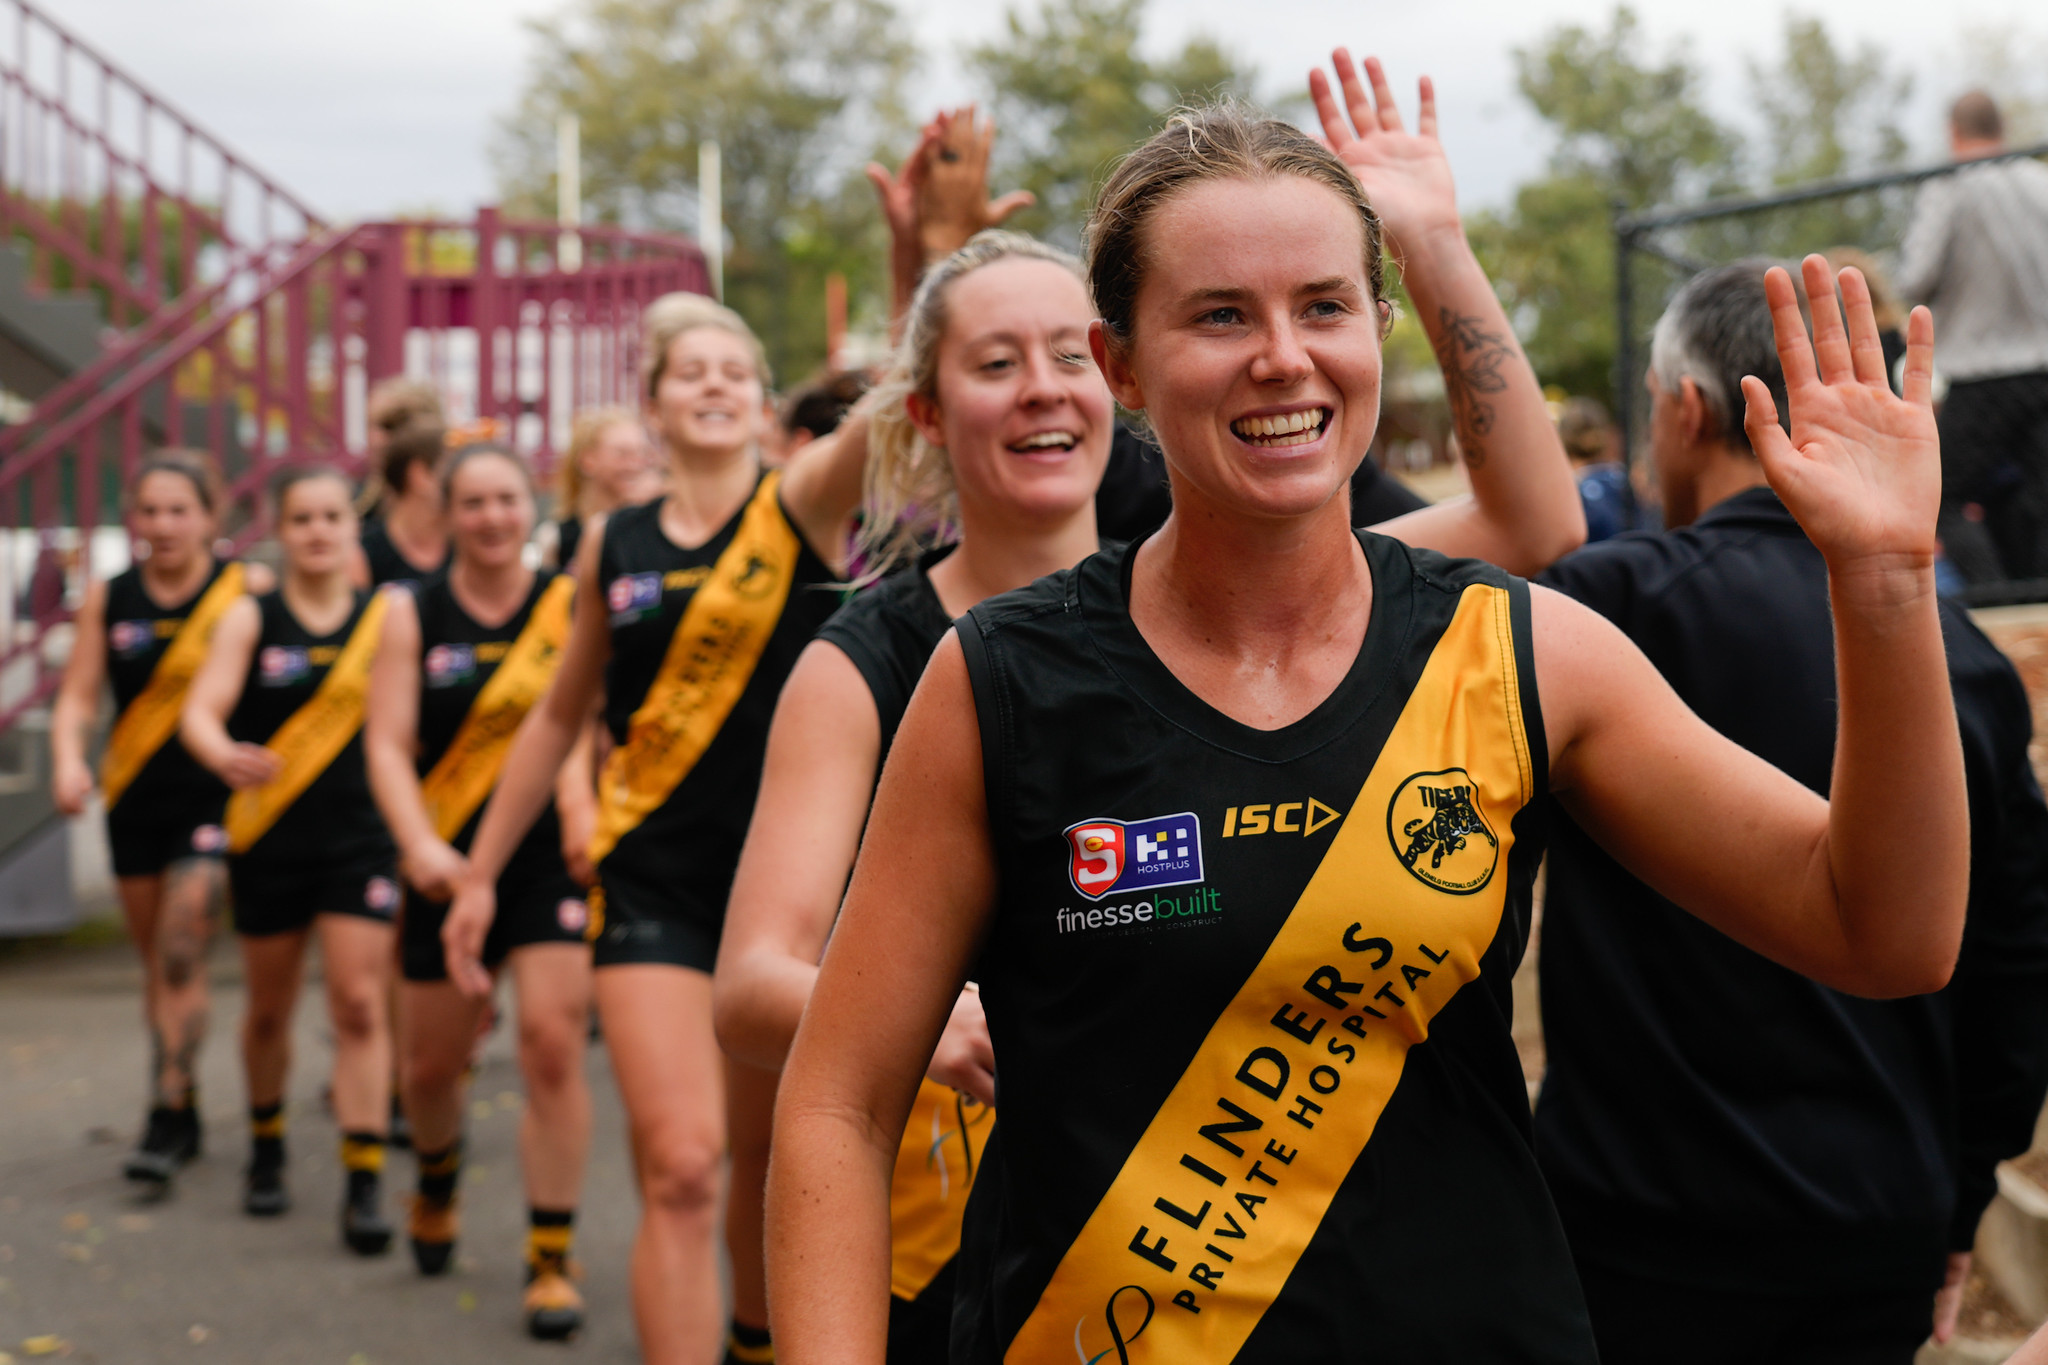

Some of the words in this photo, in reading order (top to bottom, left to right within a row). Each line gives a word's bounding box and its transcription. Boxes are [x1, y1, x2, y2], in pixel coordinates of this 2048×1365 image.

[1222, 803, 1303, 838] ISC
[1137, 860, 1190, 874] HOSTPLUS
[1442, 880, 1466, 889] FOOTBALL
[1056, 887, 1222, 933] finessebuilt
[1166, 916, 1223, 930] CONSTRUCT
[1129, 922, 1394, 1273] FLINDERS
[1172, 1138, 1298, 1315] PRIVATE
[1286, 943, 1450, 1130] HOSPITAL
